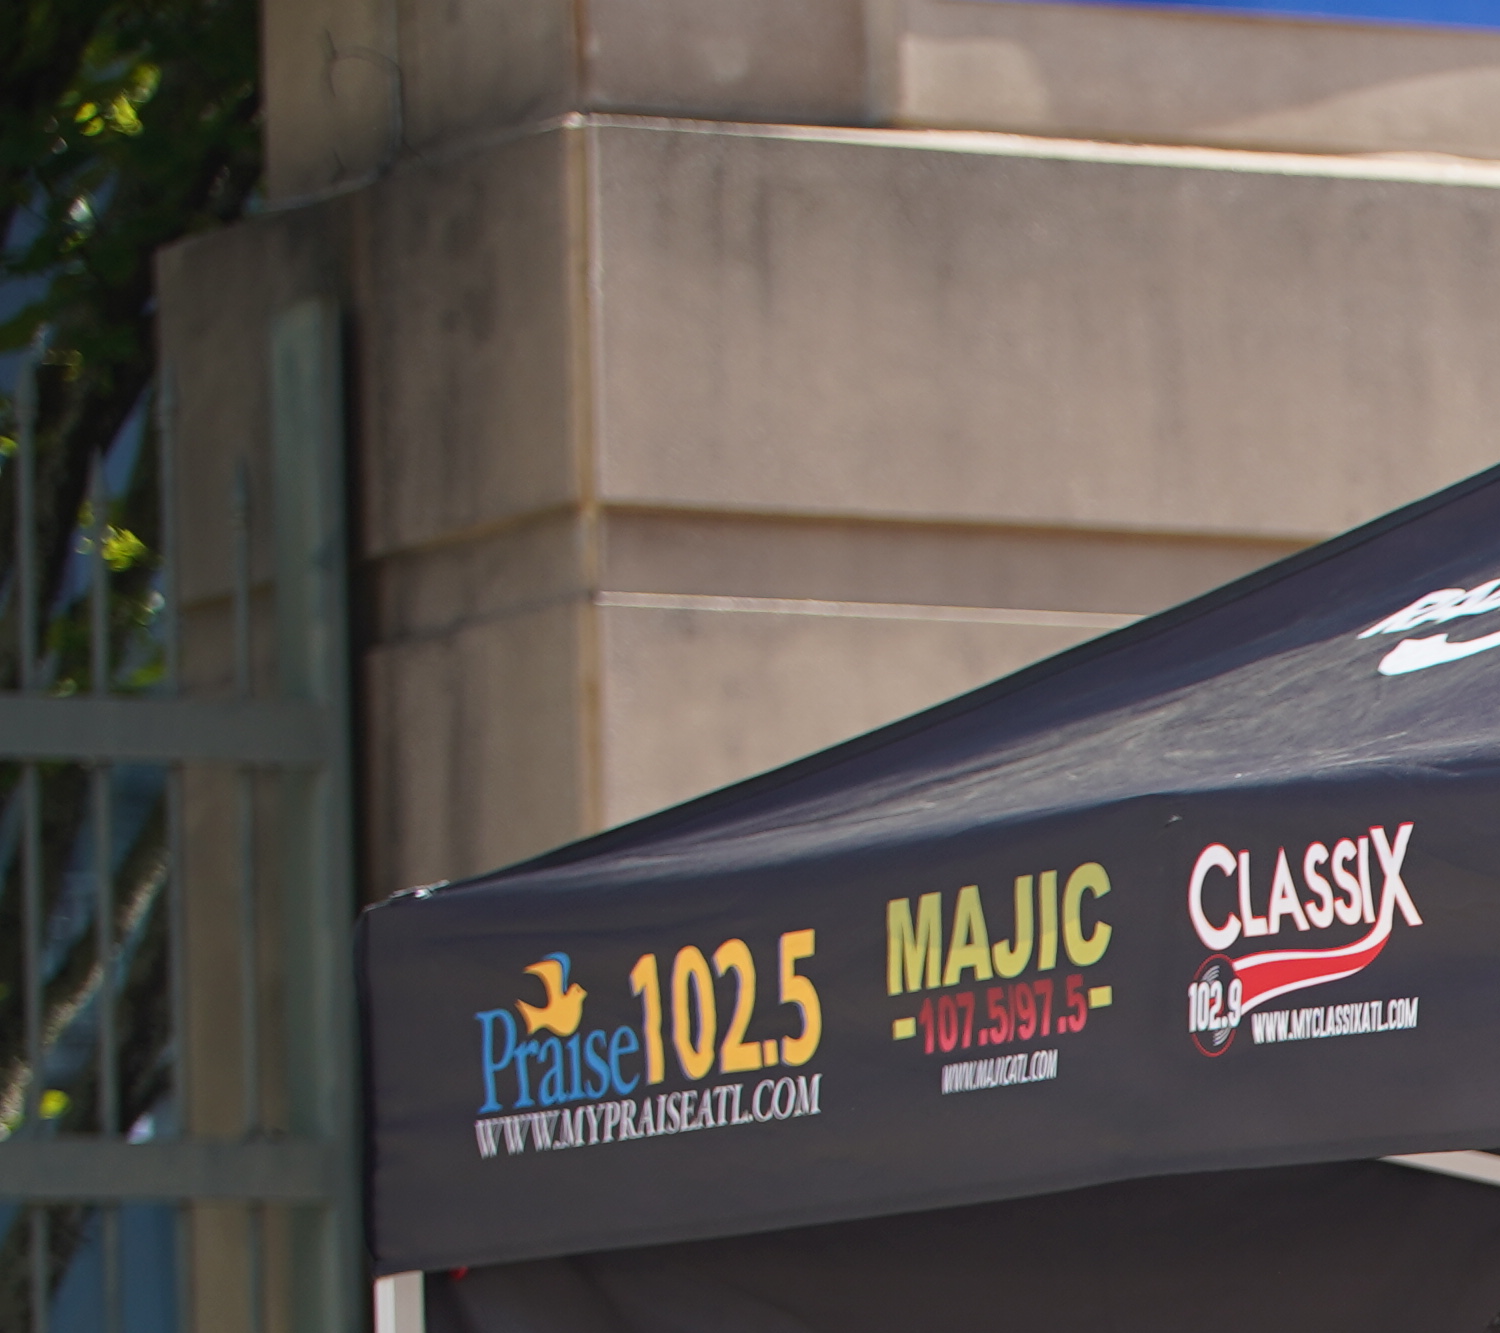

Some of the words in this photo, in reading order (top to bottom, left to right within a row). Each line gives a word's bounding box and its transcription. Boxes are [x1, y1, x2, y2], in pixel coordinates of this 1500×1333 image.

[886, 861, 1113, 996] MAJIC
[1187, 820, 1423, 952] CLASSIX
[474, 1008, 641, 1116] Praise
[629, 928, 822, 1086] 102.5
[1188, 980, 1243, 1034] 102.9
[1251, 996, 1418, 1046] WWW.MYCLASSIXATL.COM
[941, 1048, 1059, 1096] WWW.MAJICATL.COM
[473, 1073, 823, 1159] WWW.MYPRAISEATL.COM
